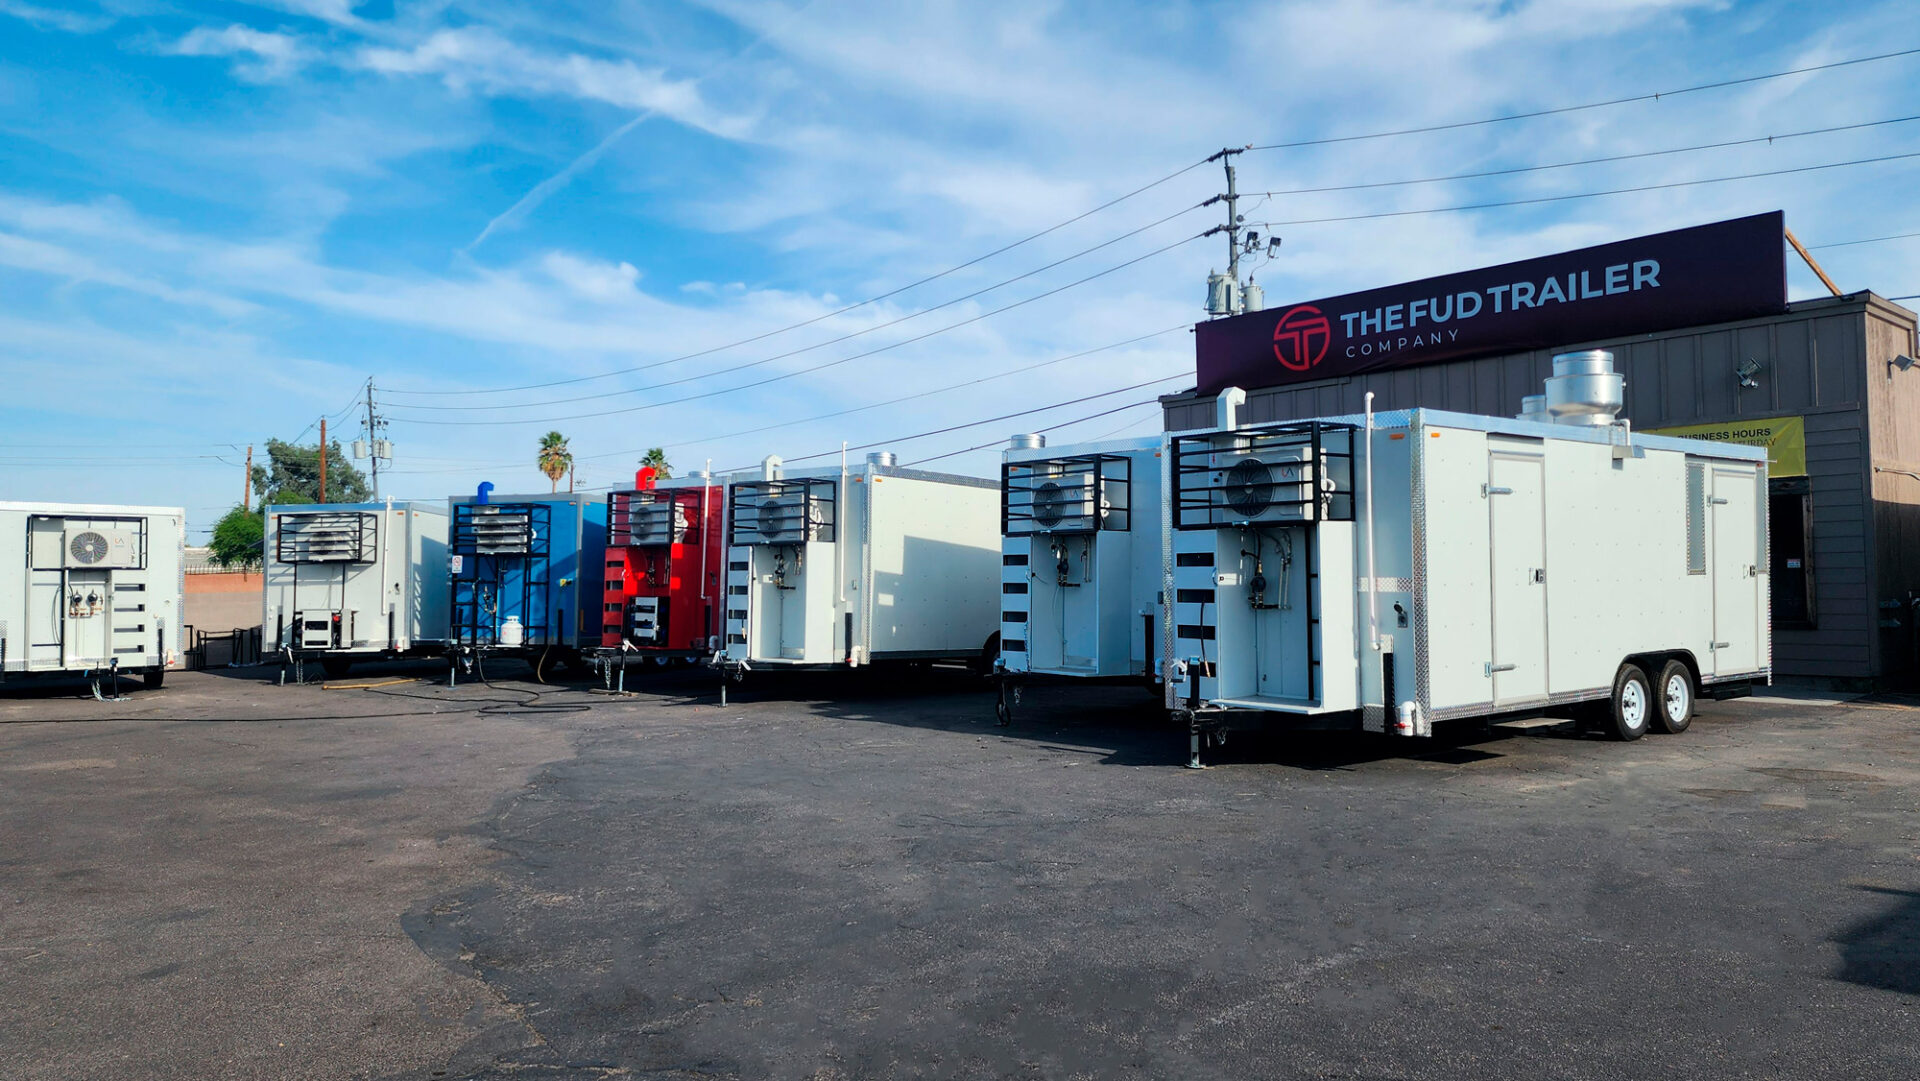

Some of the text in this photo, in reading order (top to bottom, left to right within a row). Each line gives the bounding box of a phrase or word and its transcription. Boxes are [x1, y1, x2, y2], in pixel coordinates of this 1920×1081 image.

[1340, 259, 1661, 338] THE FUD TRAILER
[1345, 328, 1459, 358] COMPANY
[1732, 428, 1771, 439] HOURS
